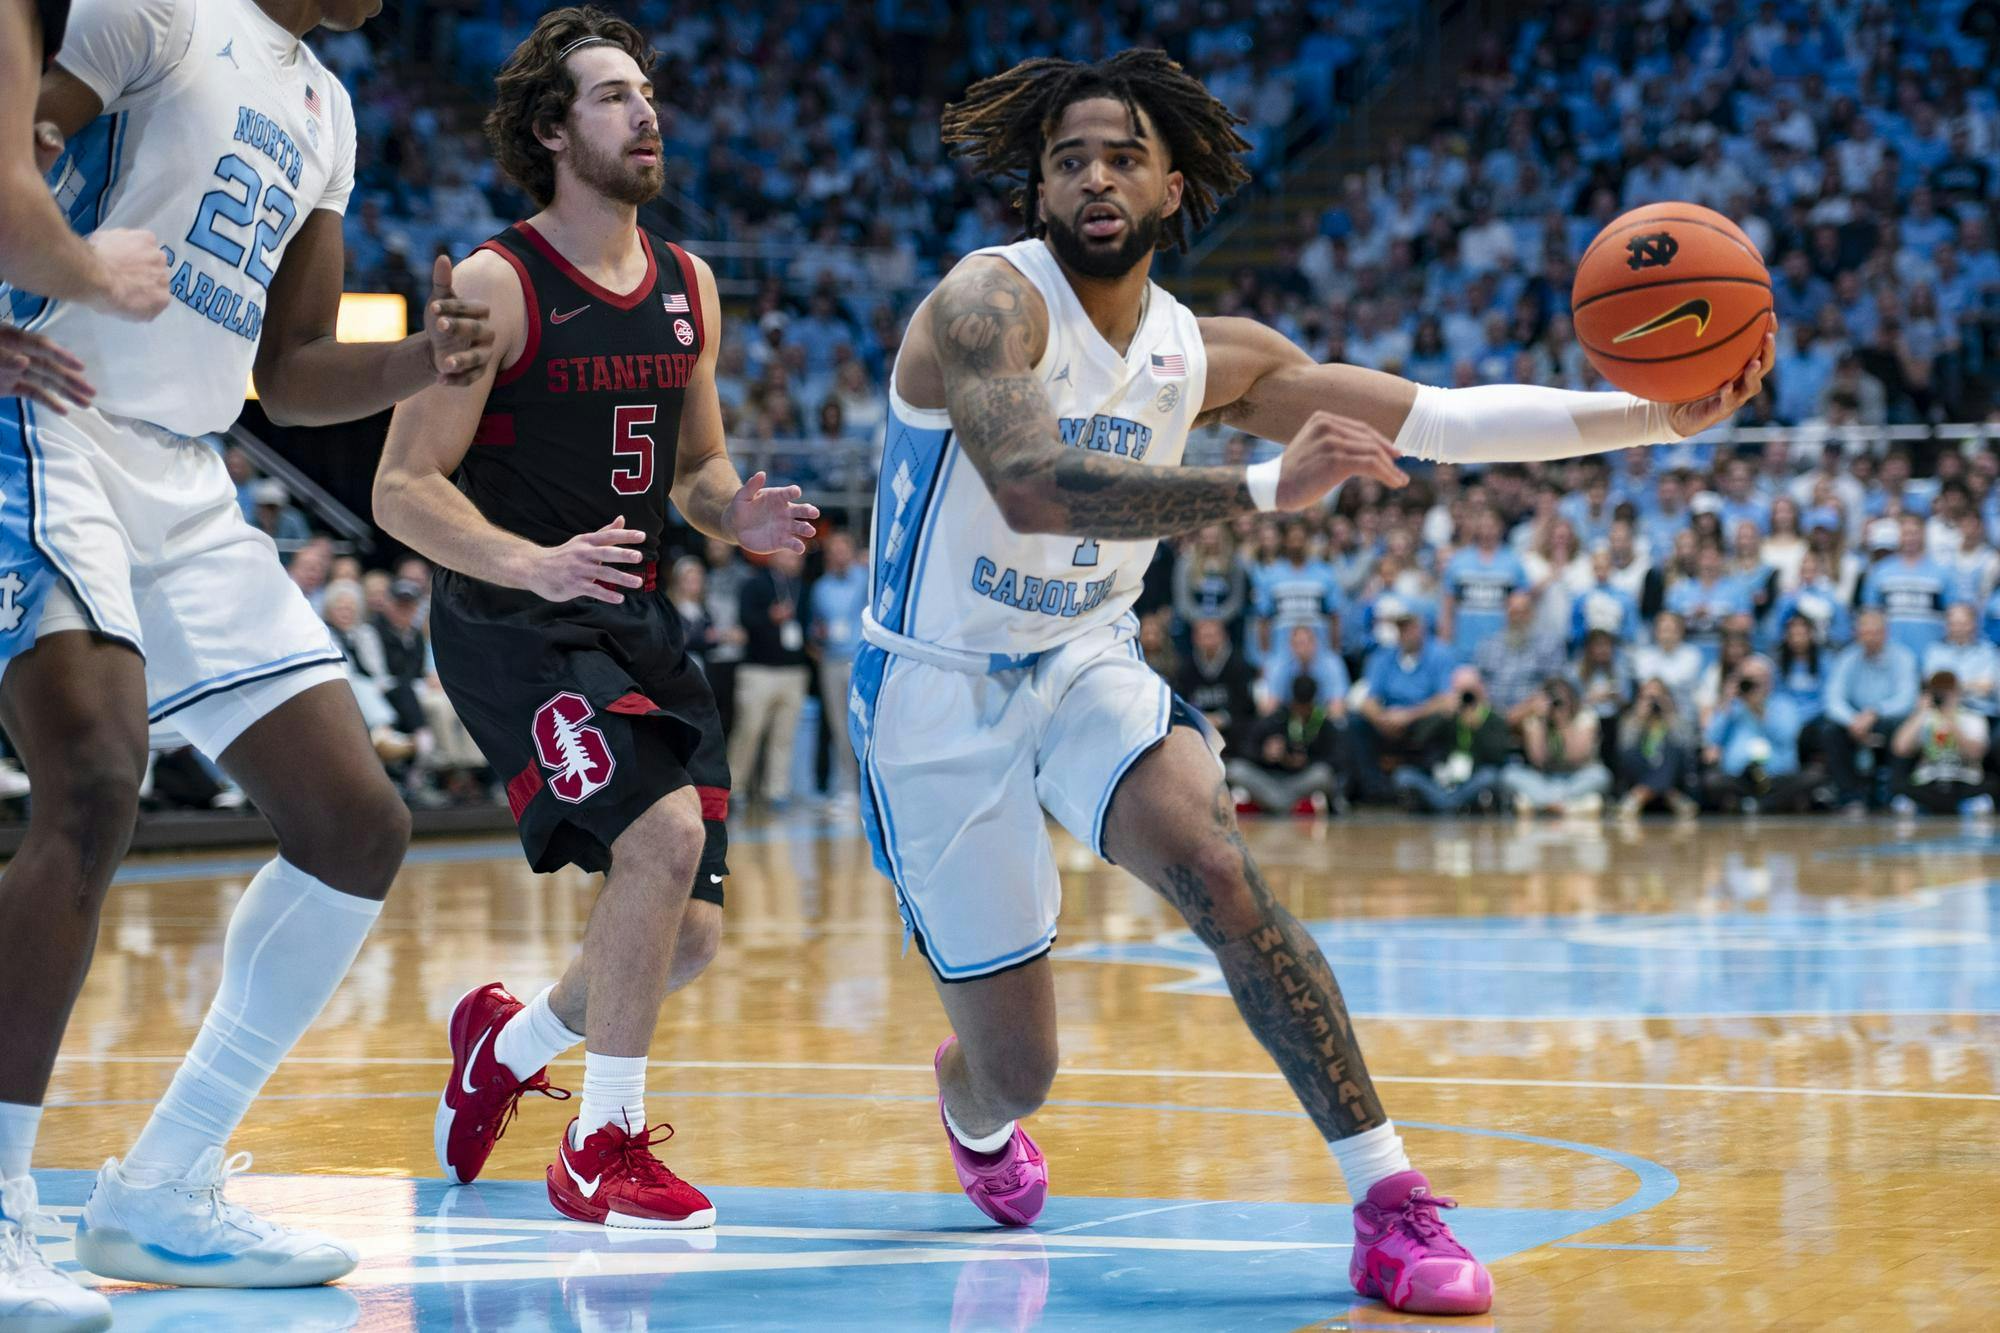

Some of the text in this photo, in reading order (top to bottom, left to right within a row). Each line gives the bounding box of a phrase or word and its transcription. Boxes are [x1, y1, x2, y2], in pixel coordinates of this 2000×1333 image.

[234, 106, 304, 188] NORTH
[185, 153, 297, 291] 22
[611, 404, 657, 495] 5
